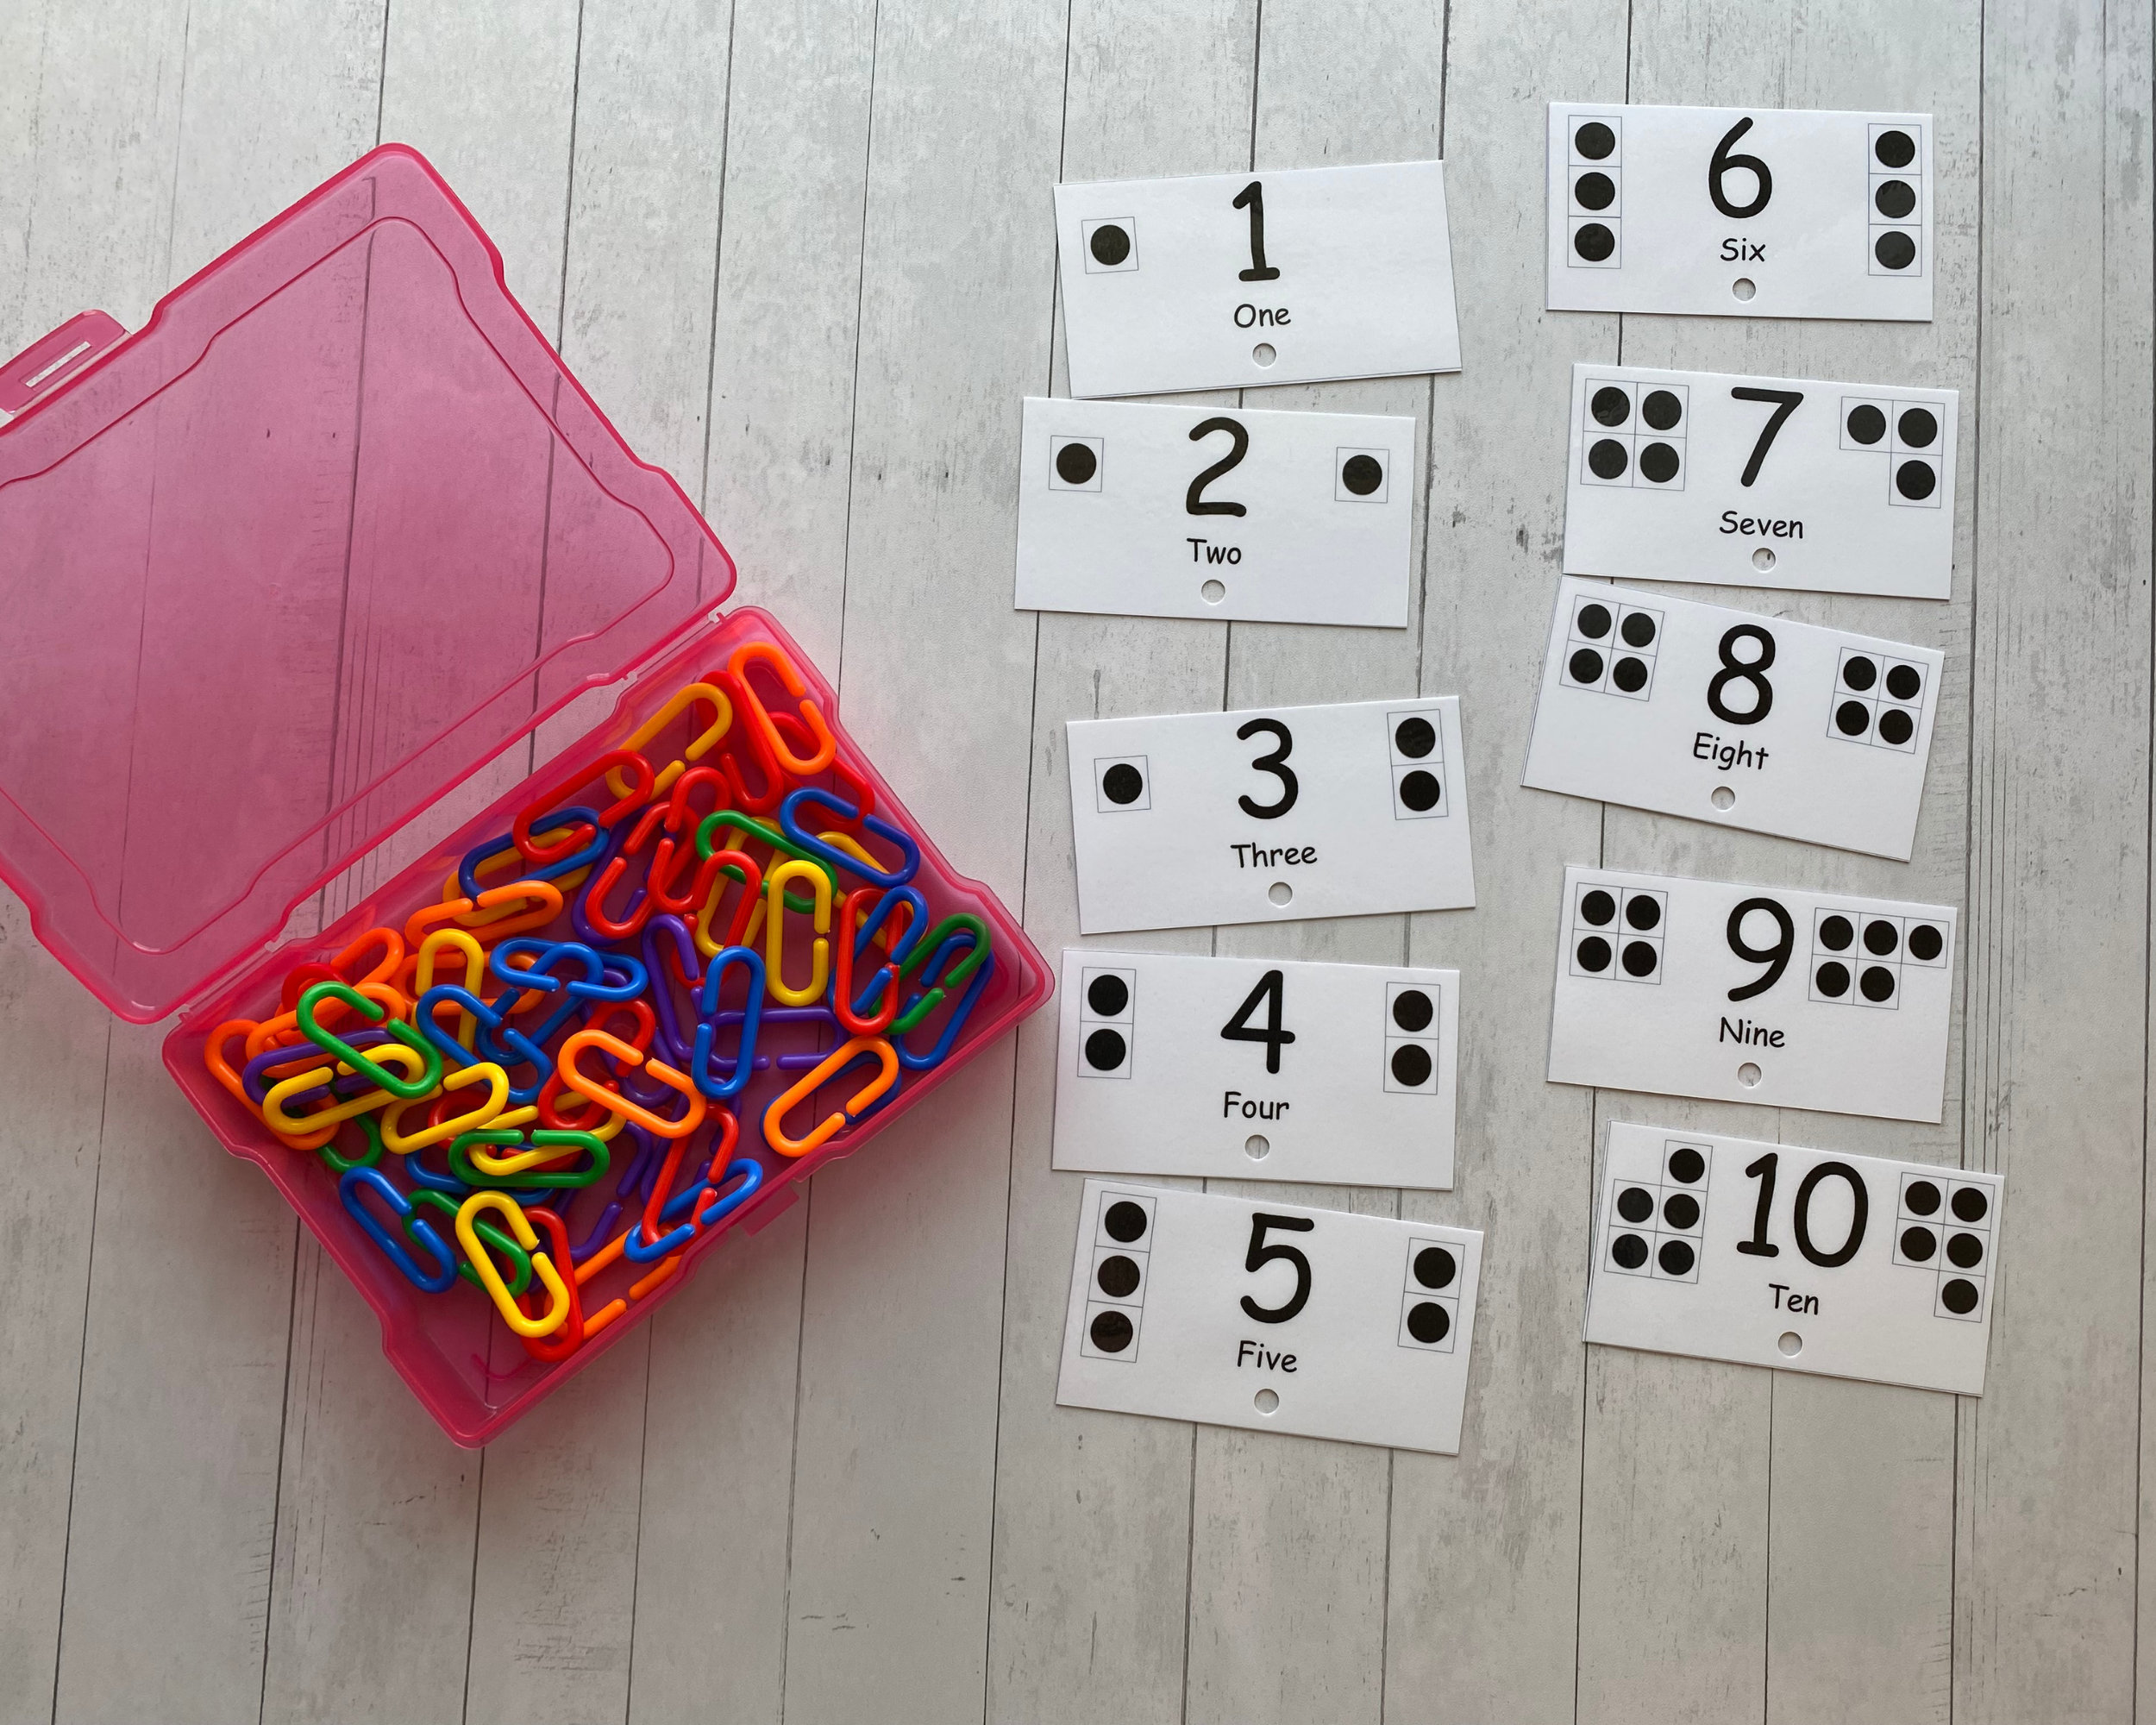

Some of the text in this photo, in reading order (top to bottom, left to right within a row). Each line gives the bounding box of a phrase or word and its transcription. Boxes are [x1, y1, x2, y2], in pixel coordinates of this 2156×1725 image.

[1708, 116, 1773, 219] 6
[1232, 180, 1281, 282] 1
[1720, 237, 1766, 262] Six
[1233, 303, 1292, 329] One
[1185, 416, 1250, 518] 2
[1730, 386, 1804, 488] 7
[1186, 537, 1242, 565] Two
[1719, 510, 1803, 540] Seven
[1707, 624, 1777, 725] 8
[1236, 718, 1299, 820] 3
[1693, 731, 1770, 771] Eight
[1230, 841, 1318, 869] Three
[1726, 897, 1795, 1002] 9
[1219, 969, 1296, 1075] 4
[1719, 1016, 1786, 1049] Nine
[1223, 1090, 1290, 1120] Four
[1736, 1152, 1869, 1269] 10
[1239, 1212, 1315, 1325] 5
[1768, 1283, 1820, 1316] Ten
[1237, 1339, 1298, 1373] Five
